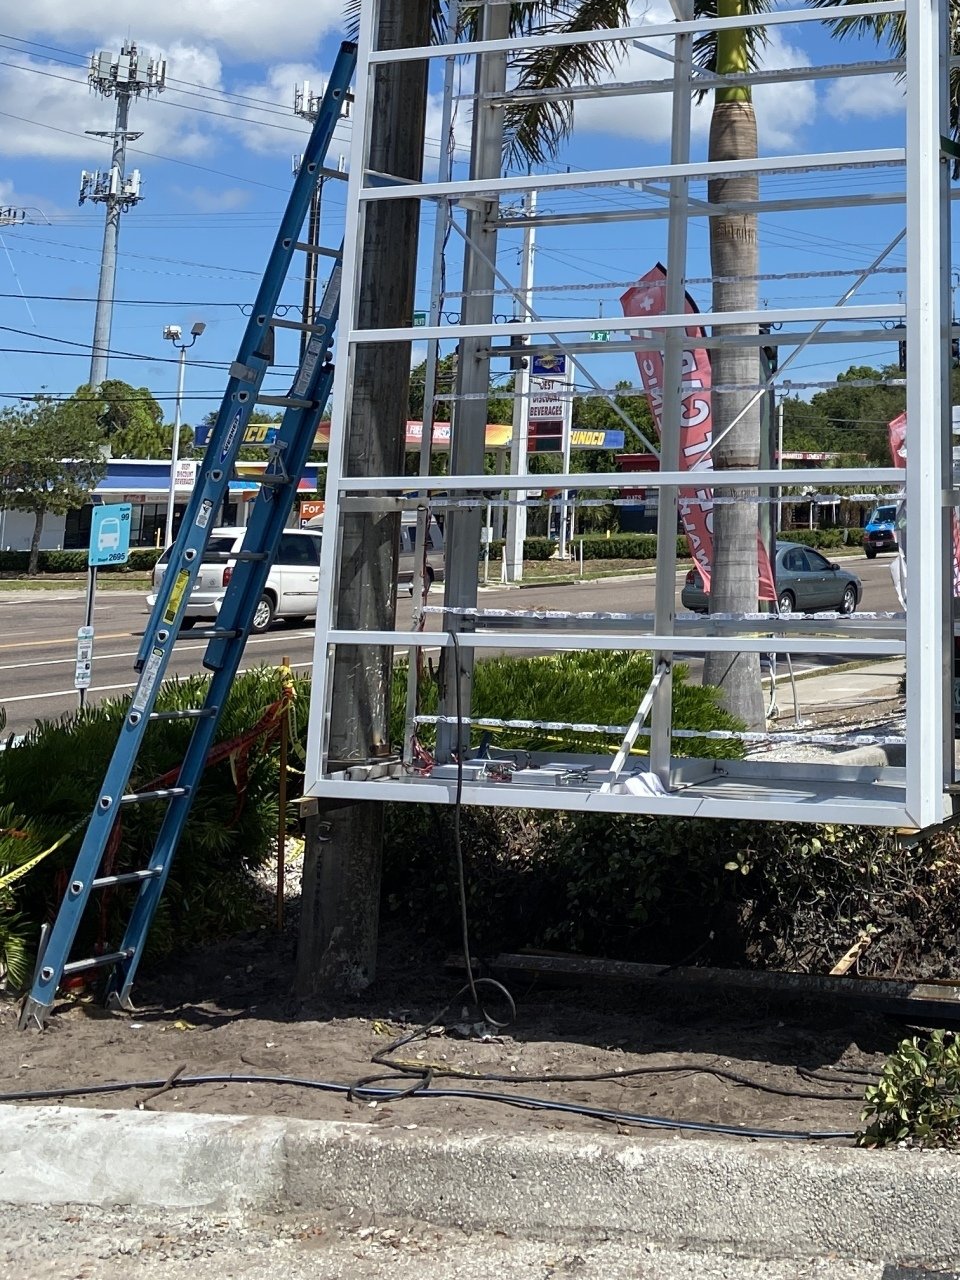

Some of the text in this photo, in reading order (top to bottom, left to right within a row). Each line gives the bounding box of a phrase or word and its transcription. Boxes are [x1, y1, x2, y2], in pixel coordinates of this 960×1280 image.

[530, 405, 563, 417] BEVERAGES
[224, 417, 240, 452] WERNER
[568, 430, 606, 446] SUNOCO
[302, 504, 320, 514] For
[121, 513, 130, 521] 99
[108, 553, 126, 562] 2695
